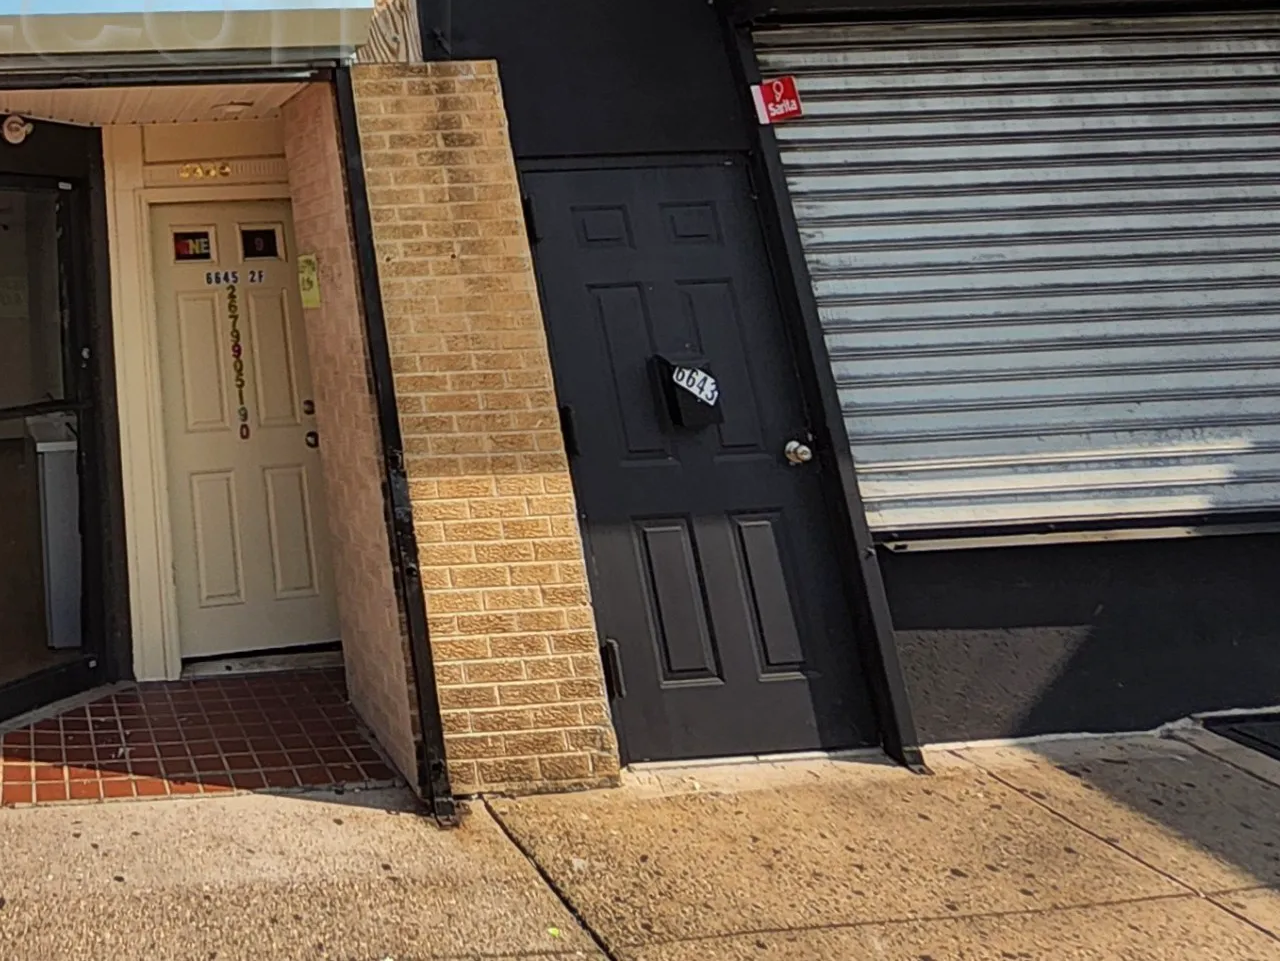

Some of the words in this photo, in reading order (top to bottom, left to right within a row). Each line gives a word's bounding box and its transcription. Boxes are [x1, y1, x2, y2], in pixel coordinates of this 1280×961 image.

[206, 270, 239, 285] 6645
[249, 270, 264, 284] 2F
[675, 366, 718, 402] 6643
